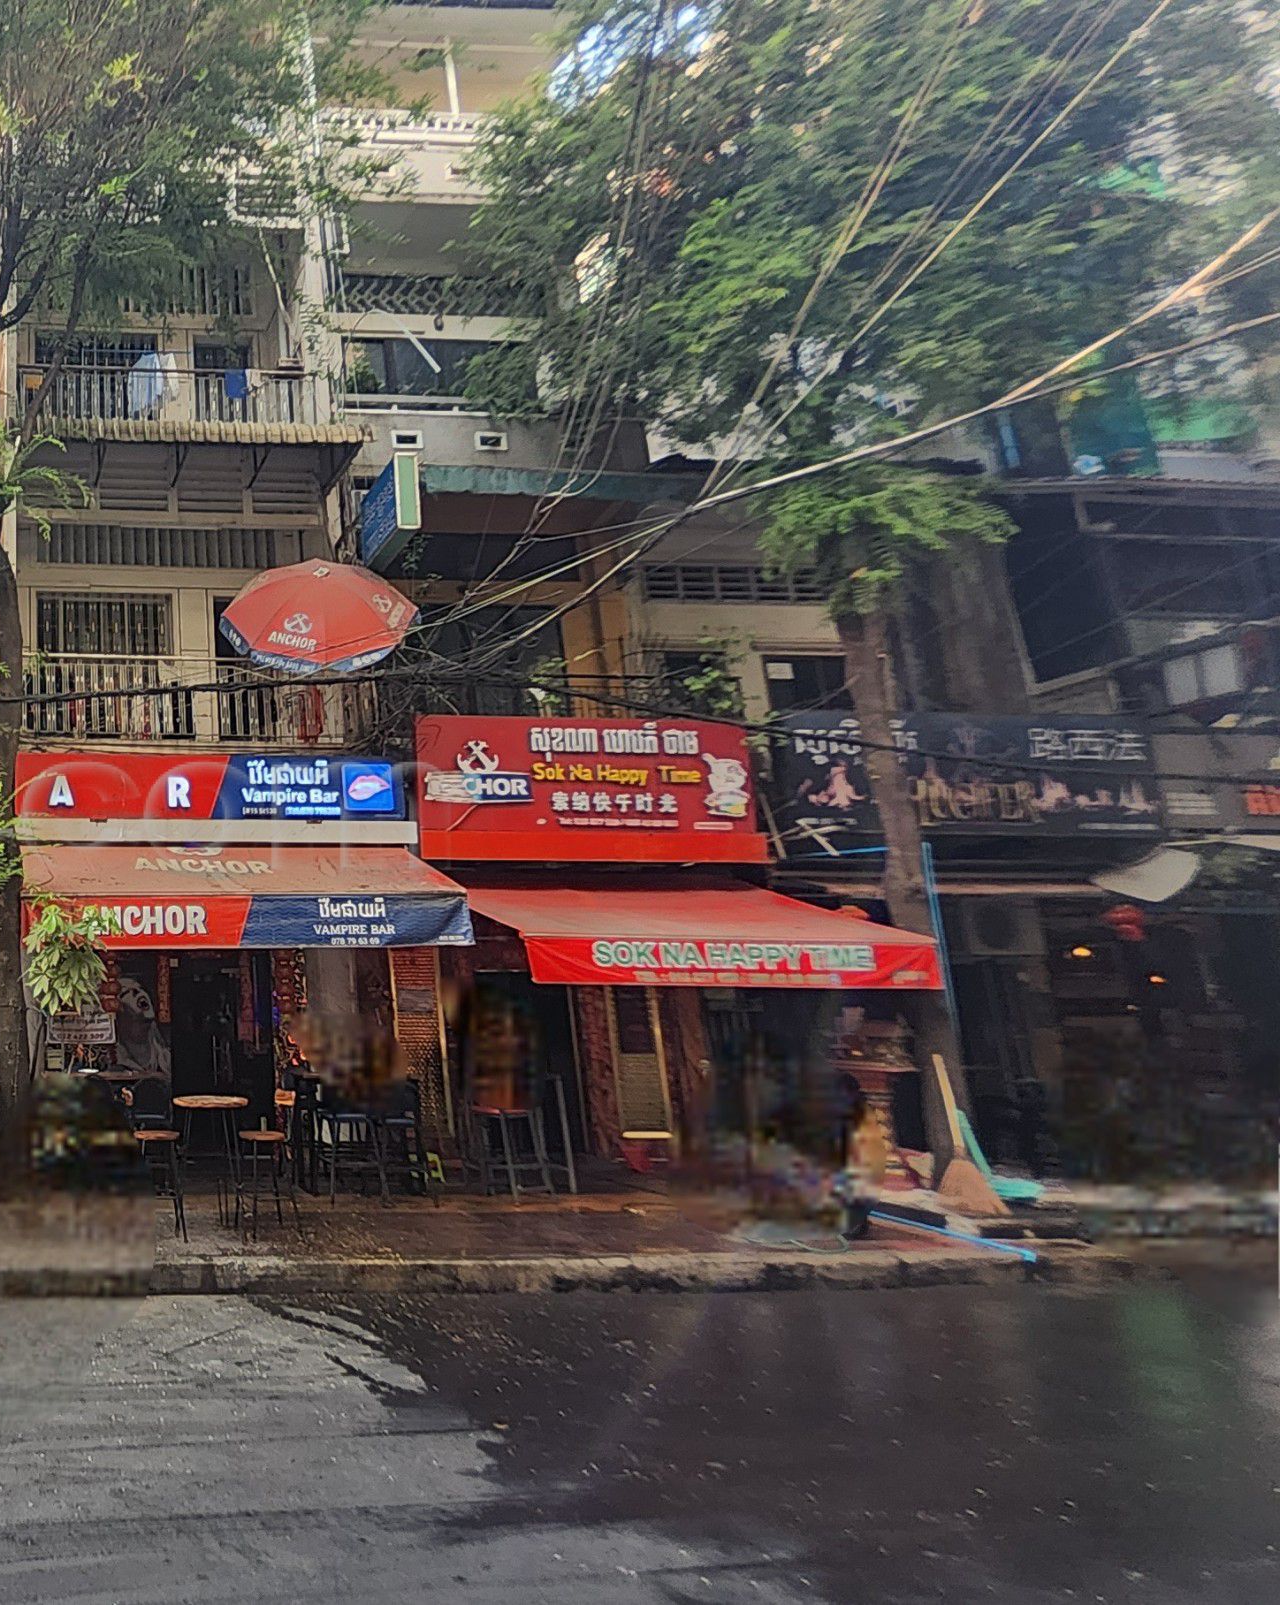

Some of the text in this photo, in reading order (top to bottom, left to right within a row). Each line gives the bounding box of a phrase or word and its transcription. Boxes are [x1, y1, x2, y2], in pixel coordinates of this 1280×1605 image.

[267, 630, 318, 651] ANCHOR
[532, 762, 566, 781] Sok
[568, 763, 593, 781] Na
[596, 764, 649, 786] Happy
[241, 787, 340, 805] Vampire Bar
[134, 857, 273, 874] ANCHOR
[94, 905, 207, 935] NCHOR
[312, 924, 395, 935] VAMPIRE BAR
[591, 940, 656, 968] SOK
[658, 942, 703, 969] NA
[706, 943, 803, 970] HAPPY
